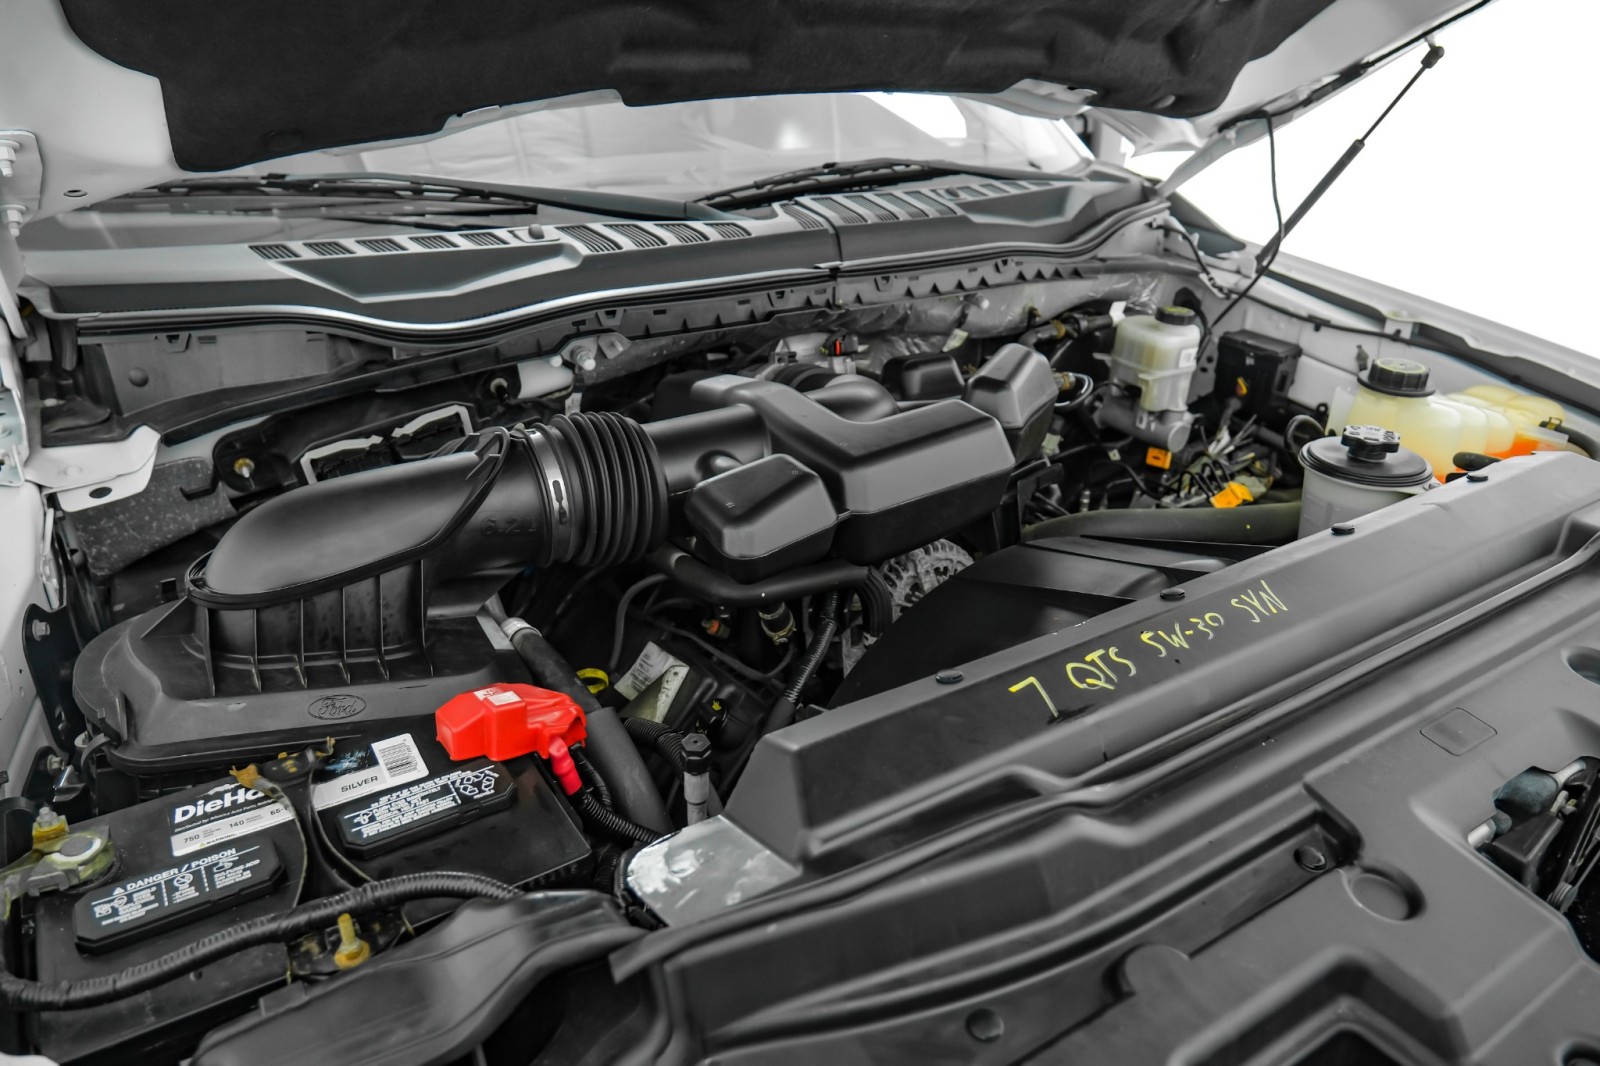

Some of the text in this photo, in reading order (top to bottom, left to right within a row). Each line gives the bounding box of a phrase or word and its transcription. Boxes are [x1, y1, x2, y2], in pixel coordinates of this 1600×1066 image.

[1008, 676, 1060, 718] 7
[1066, 646, 1136, 690] QTS
[1231, 580, 1288, 623] SYN
[315, 696, 360, 719] Ford
[340, 775, 379, 793] SILVER
[174, 787, 266, 823] DieHa
[183, 834, 200, 843] 750
[126, 867, 179, 891] DANGER
[191, 848, 237, 868] POISON
